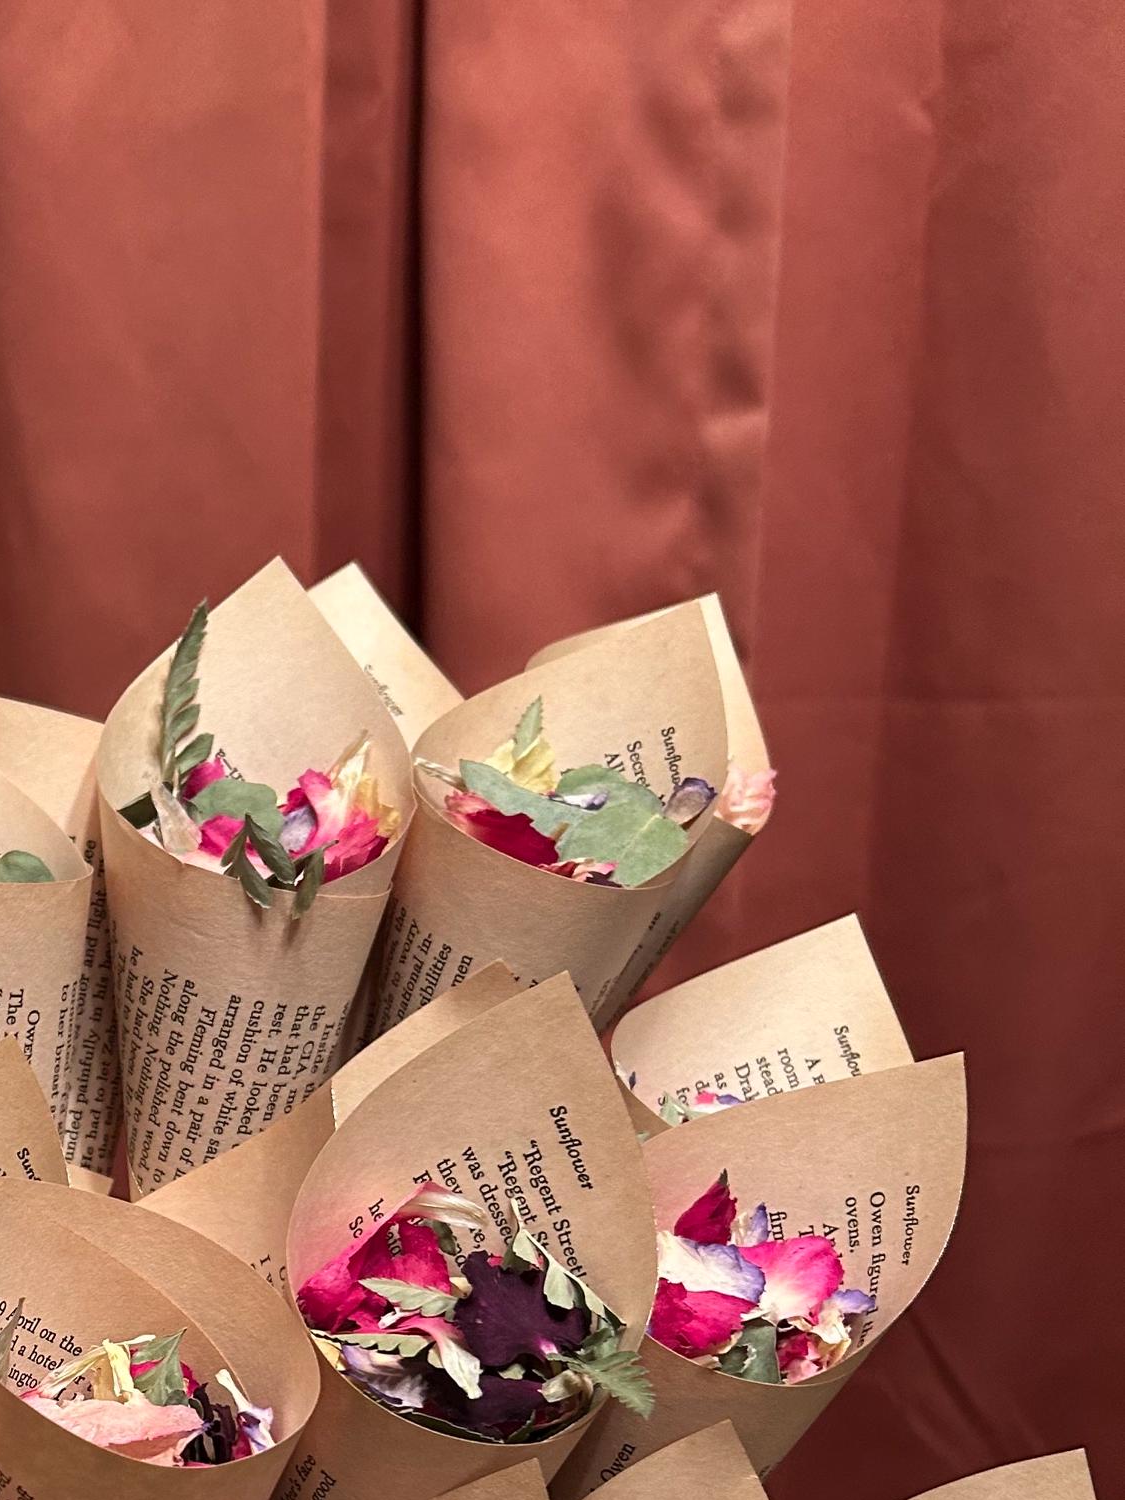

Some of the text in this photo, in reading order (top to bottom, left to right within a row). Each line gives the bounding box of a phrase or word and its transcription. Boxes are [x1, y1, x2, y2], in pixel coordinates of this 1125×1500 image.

[170, 1005, 218, 1117] Fleming bent
[185, 994, 242, 1145] arranged in a pair
[212, 1000, 265, 1136] cushion of white
[236, 1002, 288, 1136] rest. He looked
[262, 1004, 311, 1122] that had been
[777, 1047, 800, 1089] room
[461, 1146, 485, 1181] was
[549, 1105, 594, 1190] Sunflower
[552, 1218, 588, 1279] Street!
[845, 1196, 860, 1253] ovens.
[869, 1191, 886, 1248] Owen
[901, 1184, 920, 1266] Sunflower
[39, 1328, 57, 1344] on
[58, 1335, 83, 1357] the
